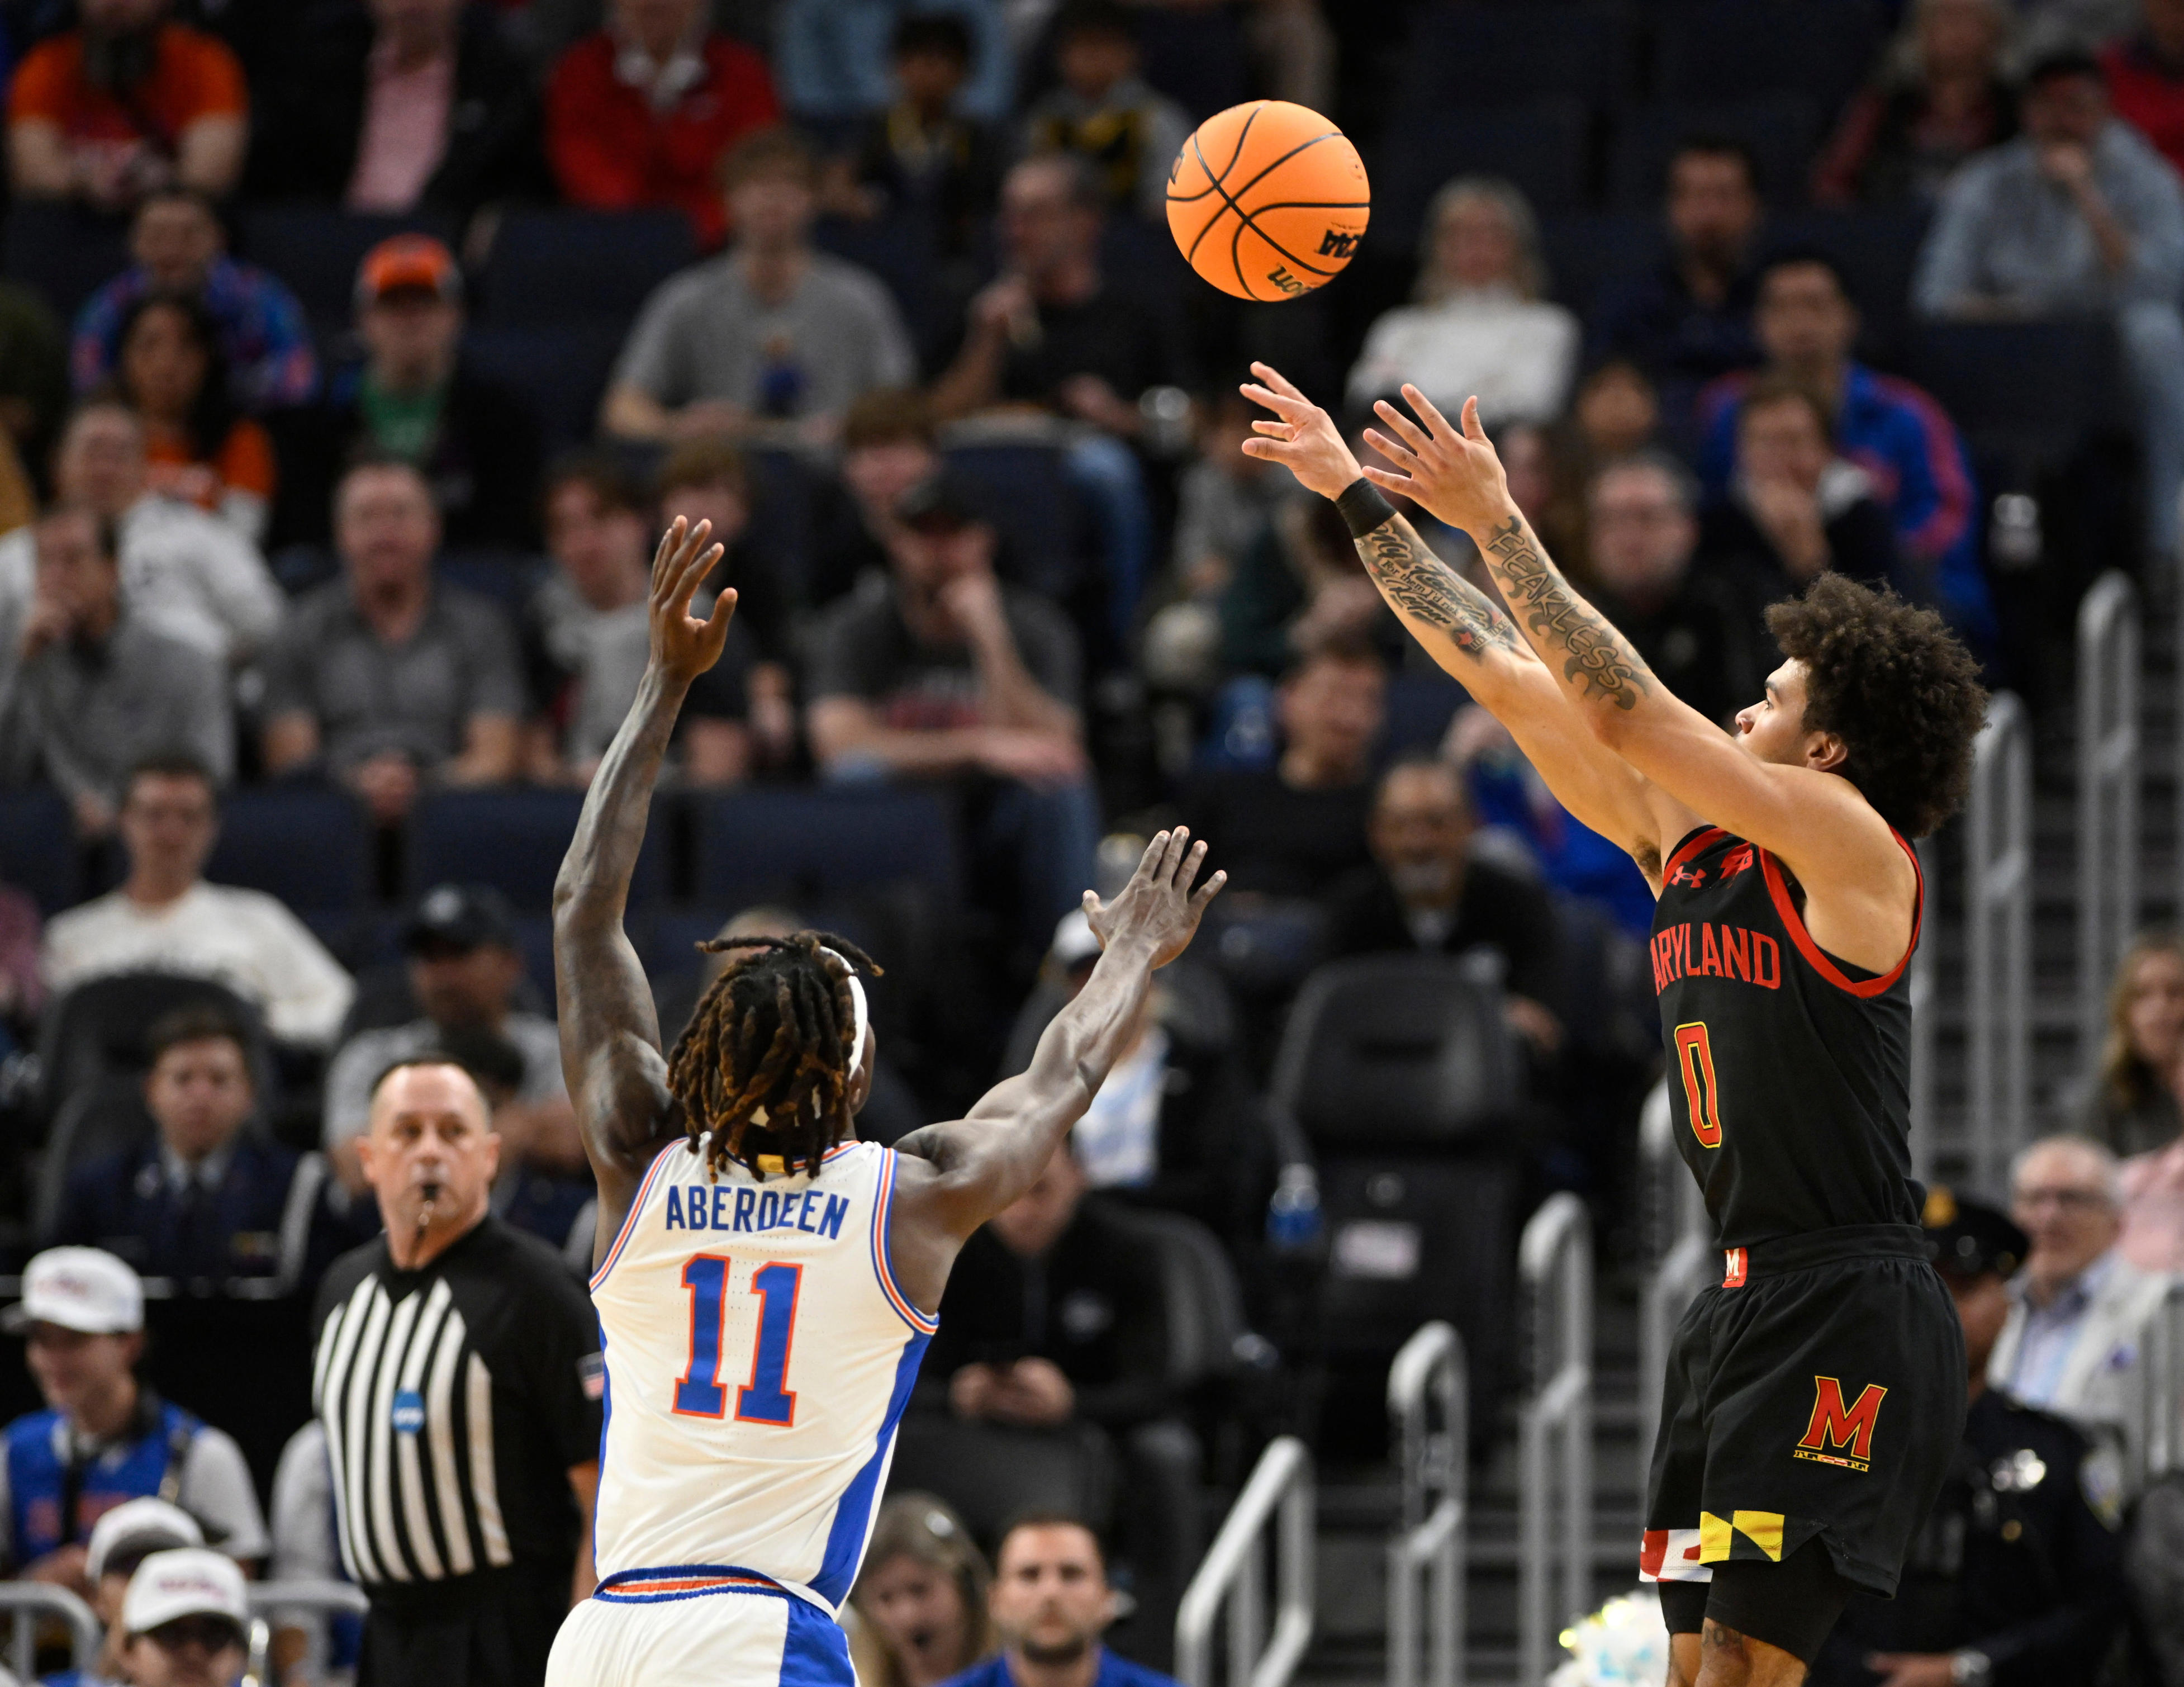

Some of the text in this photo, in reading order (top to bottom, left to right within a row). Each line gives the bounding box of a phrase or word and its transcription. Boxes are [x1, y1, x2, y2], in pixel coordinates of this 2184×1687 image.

[1381, 561, 1399, 575] For
[1400, 574, 1425, 593] them
[1487, 532, 1632, 689] FEARLESS
[1650, 922, 1781, 996] ARYLAND
[1674, 1021, 1722, 1148] 0
[666, 1185, 849, 1240] ABERDEEN
[1726, 1248, 1740, 1277] M
[671, 1253, 803, 1427] 11
[1797, 1375, 1888, 1461] M
